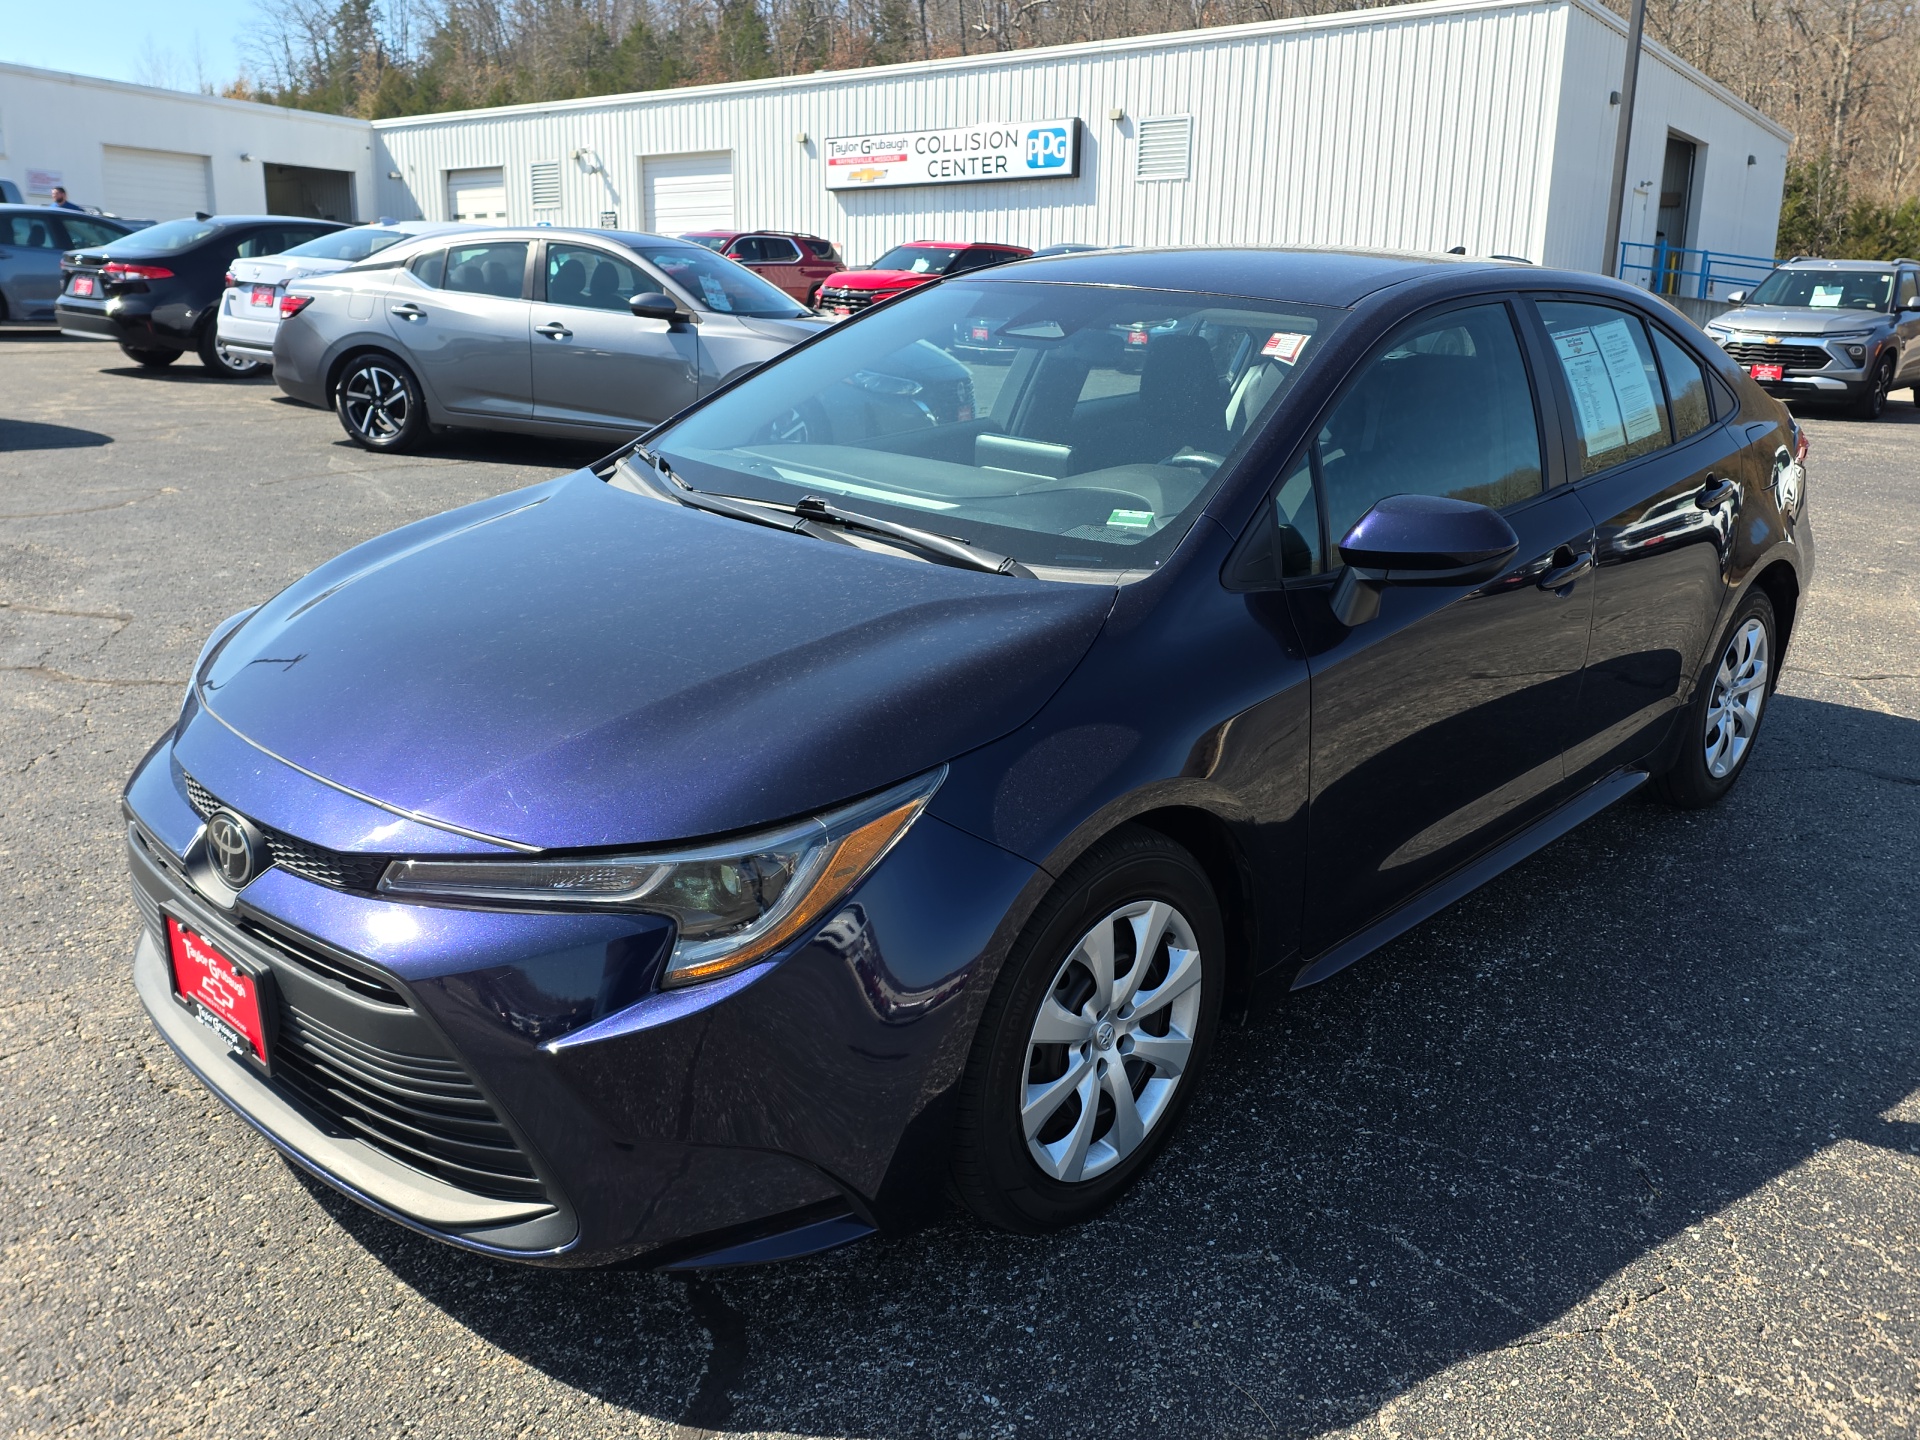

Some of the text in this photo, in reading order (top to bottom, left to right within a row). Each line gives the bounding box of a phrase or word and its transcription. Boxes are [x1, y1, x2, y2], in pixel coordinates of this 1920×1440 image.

[828, 138, 909, 157] Taylor Grubaugh
[915, 129, 1019, 155] COLLISION
[1027, 131, 1066, 166] PPG
[927, 155, 1008, 178] CENTER
[182, 938, 246, 998] Taylor Grubaugh
